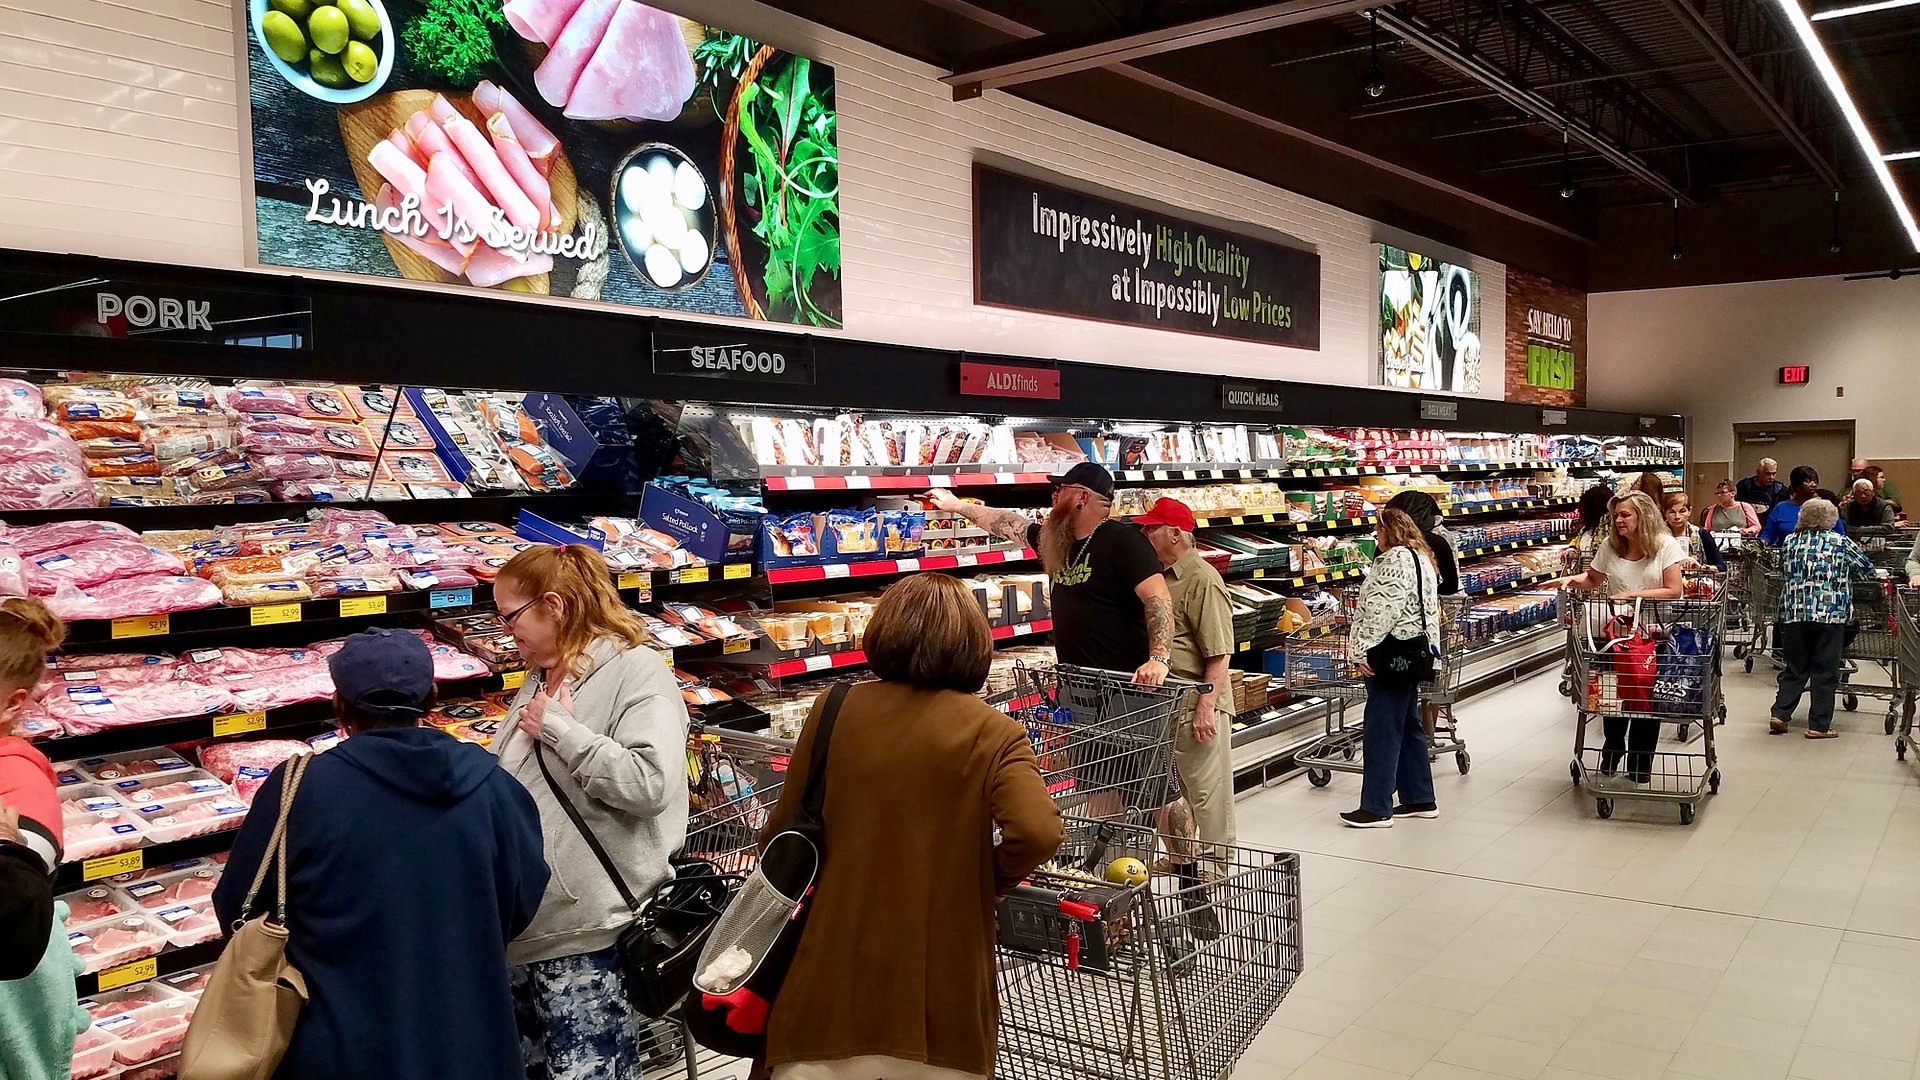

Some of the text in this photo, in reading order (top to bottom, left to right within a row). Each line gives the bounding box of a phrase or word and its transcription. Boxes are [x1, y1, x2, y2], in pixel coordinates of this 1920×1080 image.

[305, 178, 602, 261] Lunch Is Served
[1032, 192, 1250, 289] Impressively High Quality
[1111, 267, 1291, 328] at Impossibly Low Prices
[97, 292, 213, 331] PORK
[1527, 308, 1572, 342] SAY HELLO TO
[691, 345, 786, 374] SEAFOOD
[1527, 344, 1575, 391] FRESH
[987, 371, 1038, 392] ALDIfinds
[1784, 367, 1806, 383] EXIT
[1228, 390, 1280, 407] QUICK MEALS
[661, 512, 680, 526] Salted
[679, 519, 699, 534] Pollock
[281, 608, 300, 617] $2.99
[148, 620, 167, 630] $2.19
[1652, 680, 1687, 697] ROSS
[246, 715, 265, 726] $2.99
[119, 855, 140, 868] $3.89
[134, 963, 155, 976] $2.99
